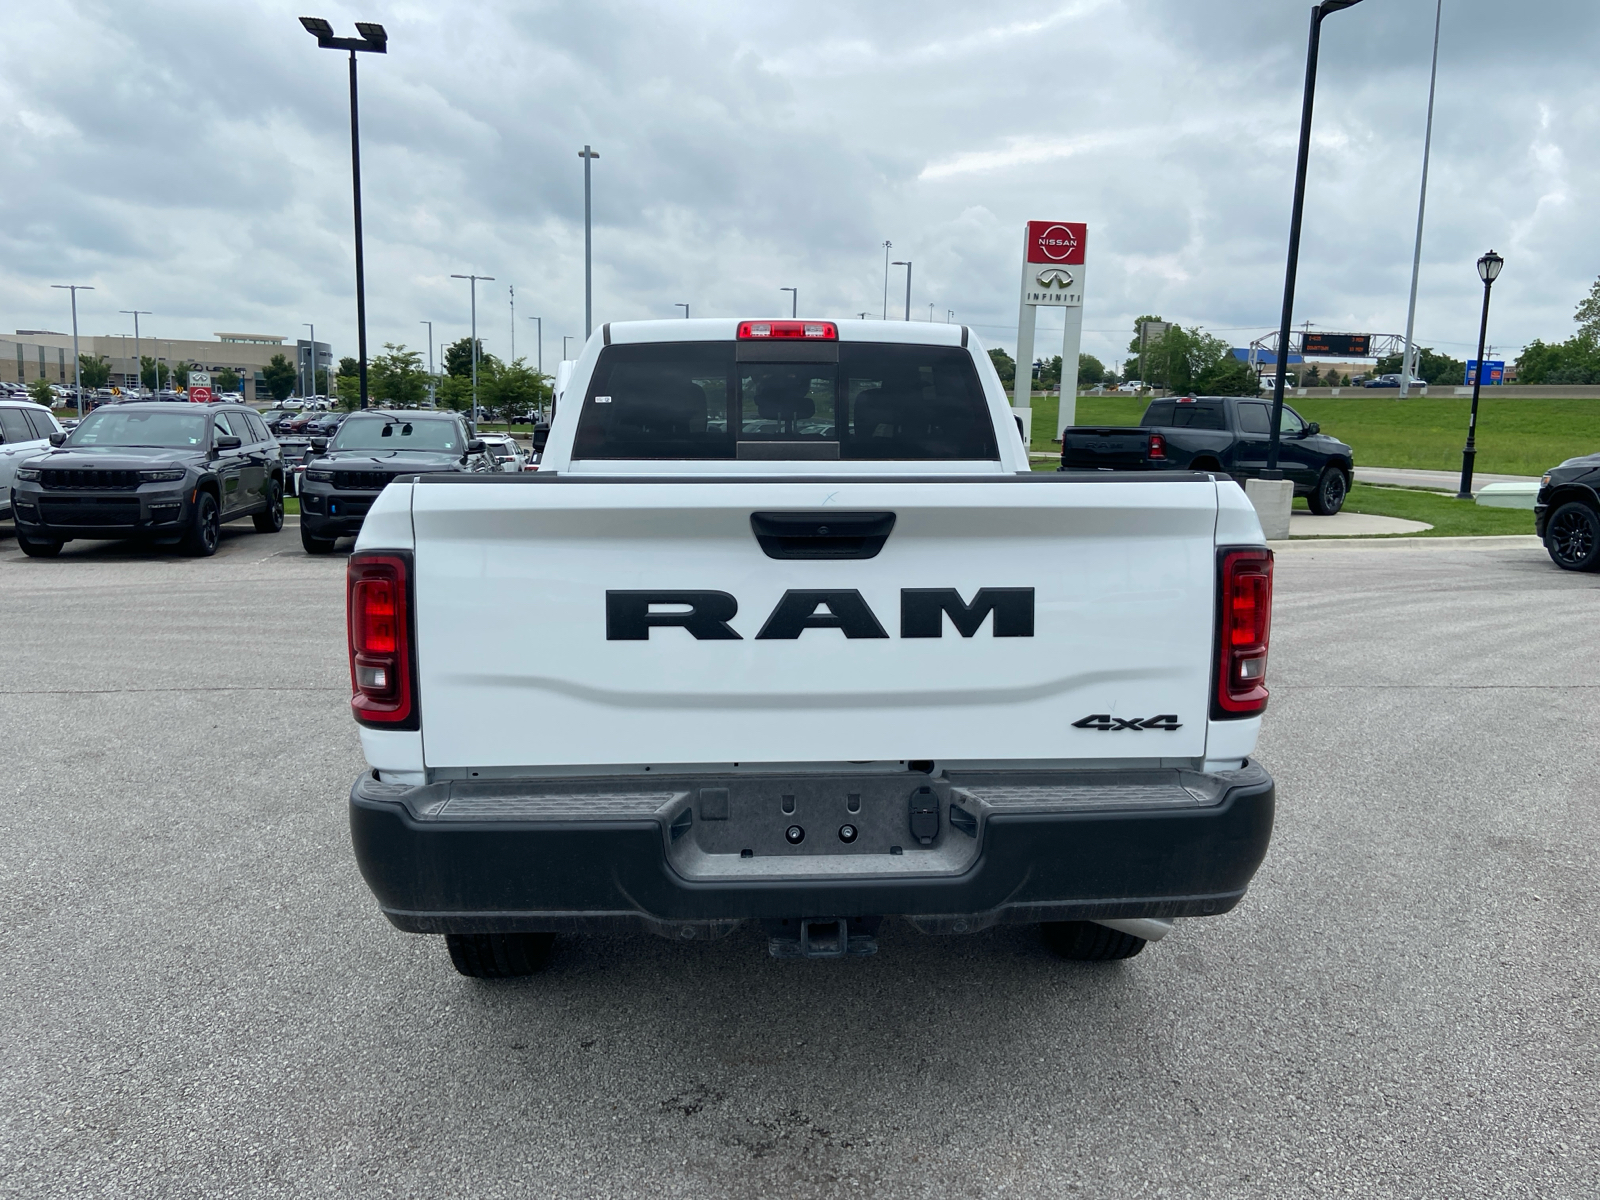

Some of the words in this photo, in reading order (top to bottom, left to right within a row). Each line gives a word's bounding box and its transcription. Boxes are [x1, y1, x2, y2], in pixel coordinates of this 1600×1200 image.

[1027, 292, 1080, 302] INFINITI
[606, 587, 1035, 640] RAM
[1071, 714, 1183, 731] 4x4
